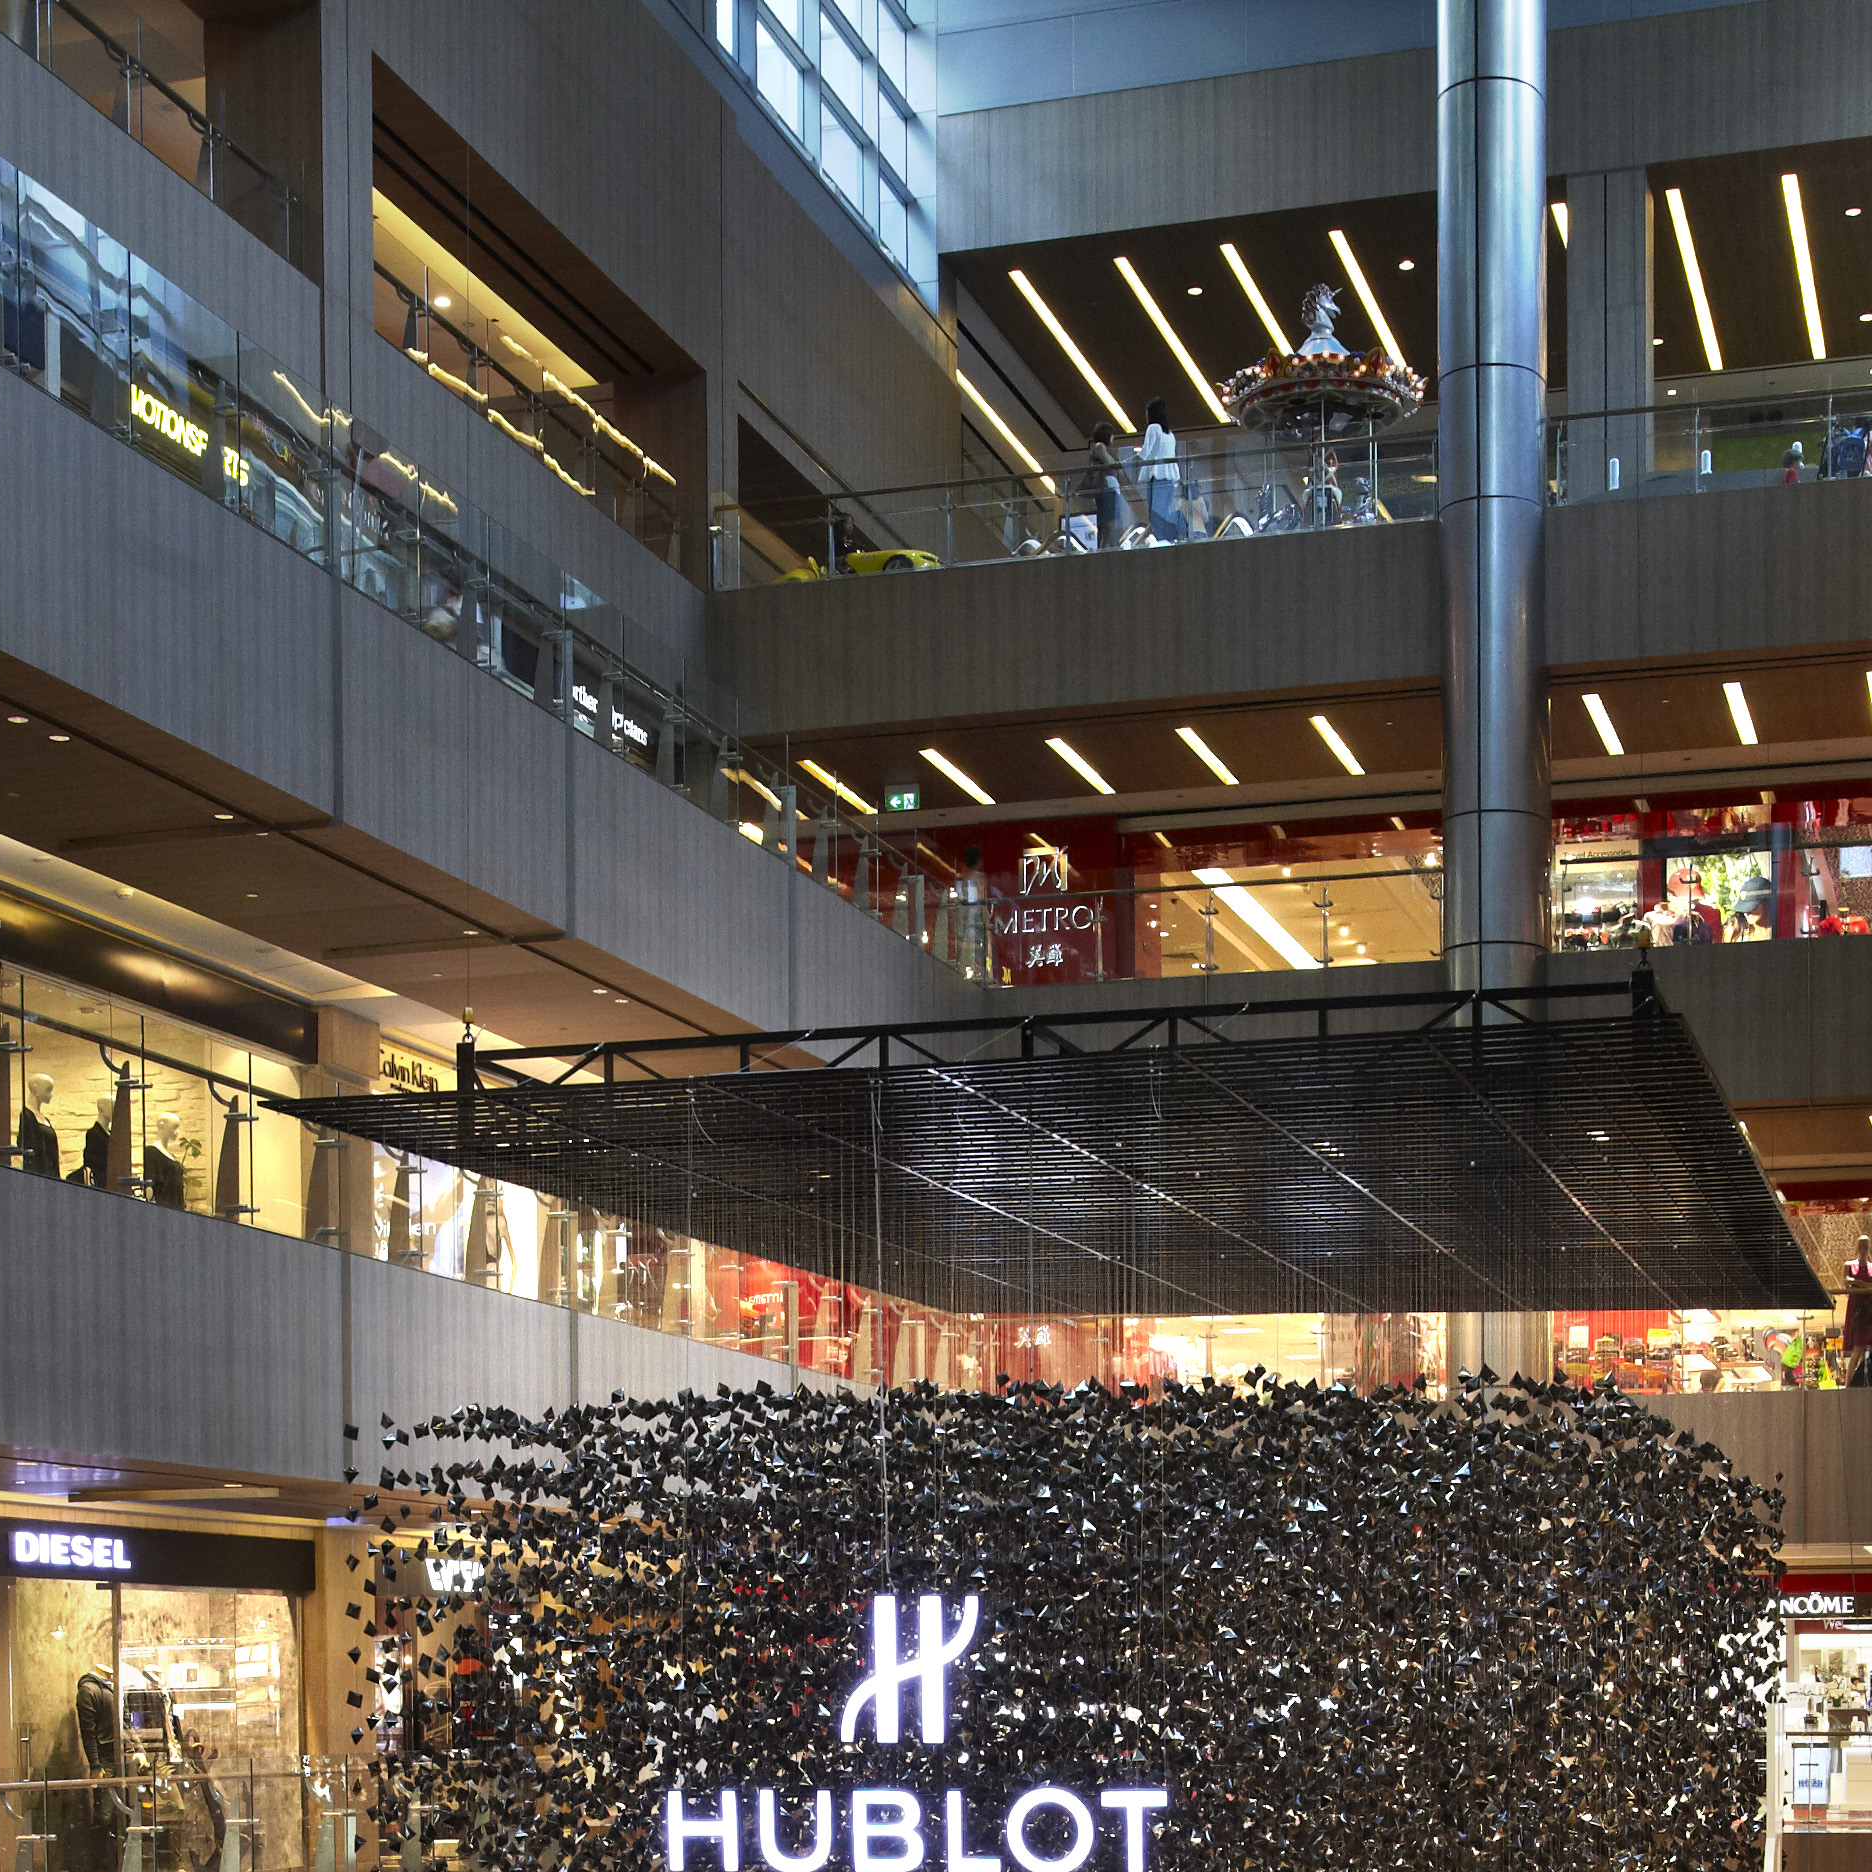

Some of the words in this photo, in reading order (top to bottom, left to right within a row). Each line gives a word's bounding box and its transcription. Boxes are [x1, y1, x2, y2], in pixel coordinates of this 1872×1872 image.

[995, 905, 1094, 936] METRO
[380, 1049, 410, 1084] alvin
[14, 1531, 132, 1569] DIESEL
